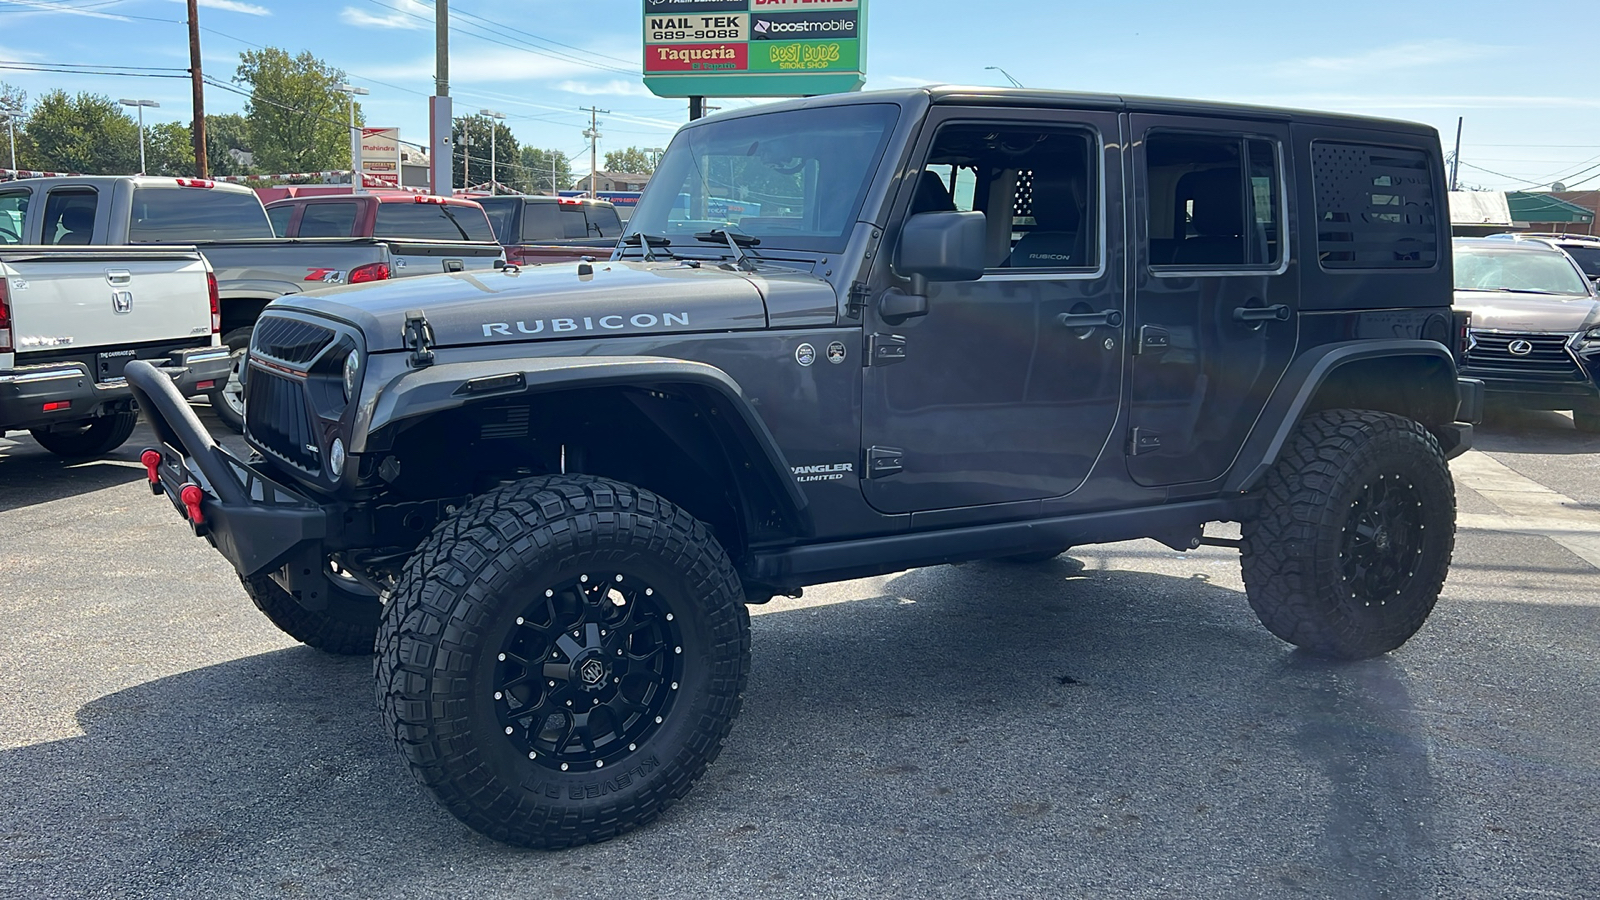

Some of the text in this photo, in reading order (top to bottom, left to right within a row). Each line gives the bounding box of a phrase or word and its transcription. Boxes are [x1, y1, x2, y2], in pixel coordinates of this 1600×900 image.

[651, 16, 740, 29] NAIL TEK
[771, 19, 854, 32] boostmobile
[653, 29, 739, 40] 689-9088
[779, 61, 828, 69] SMOKE SHOP
[1029, 253, 1070, 261] RUBICON
[303, 267, 347, 284] Z71
[481, 312, 690, 337] RUBICON
